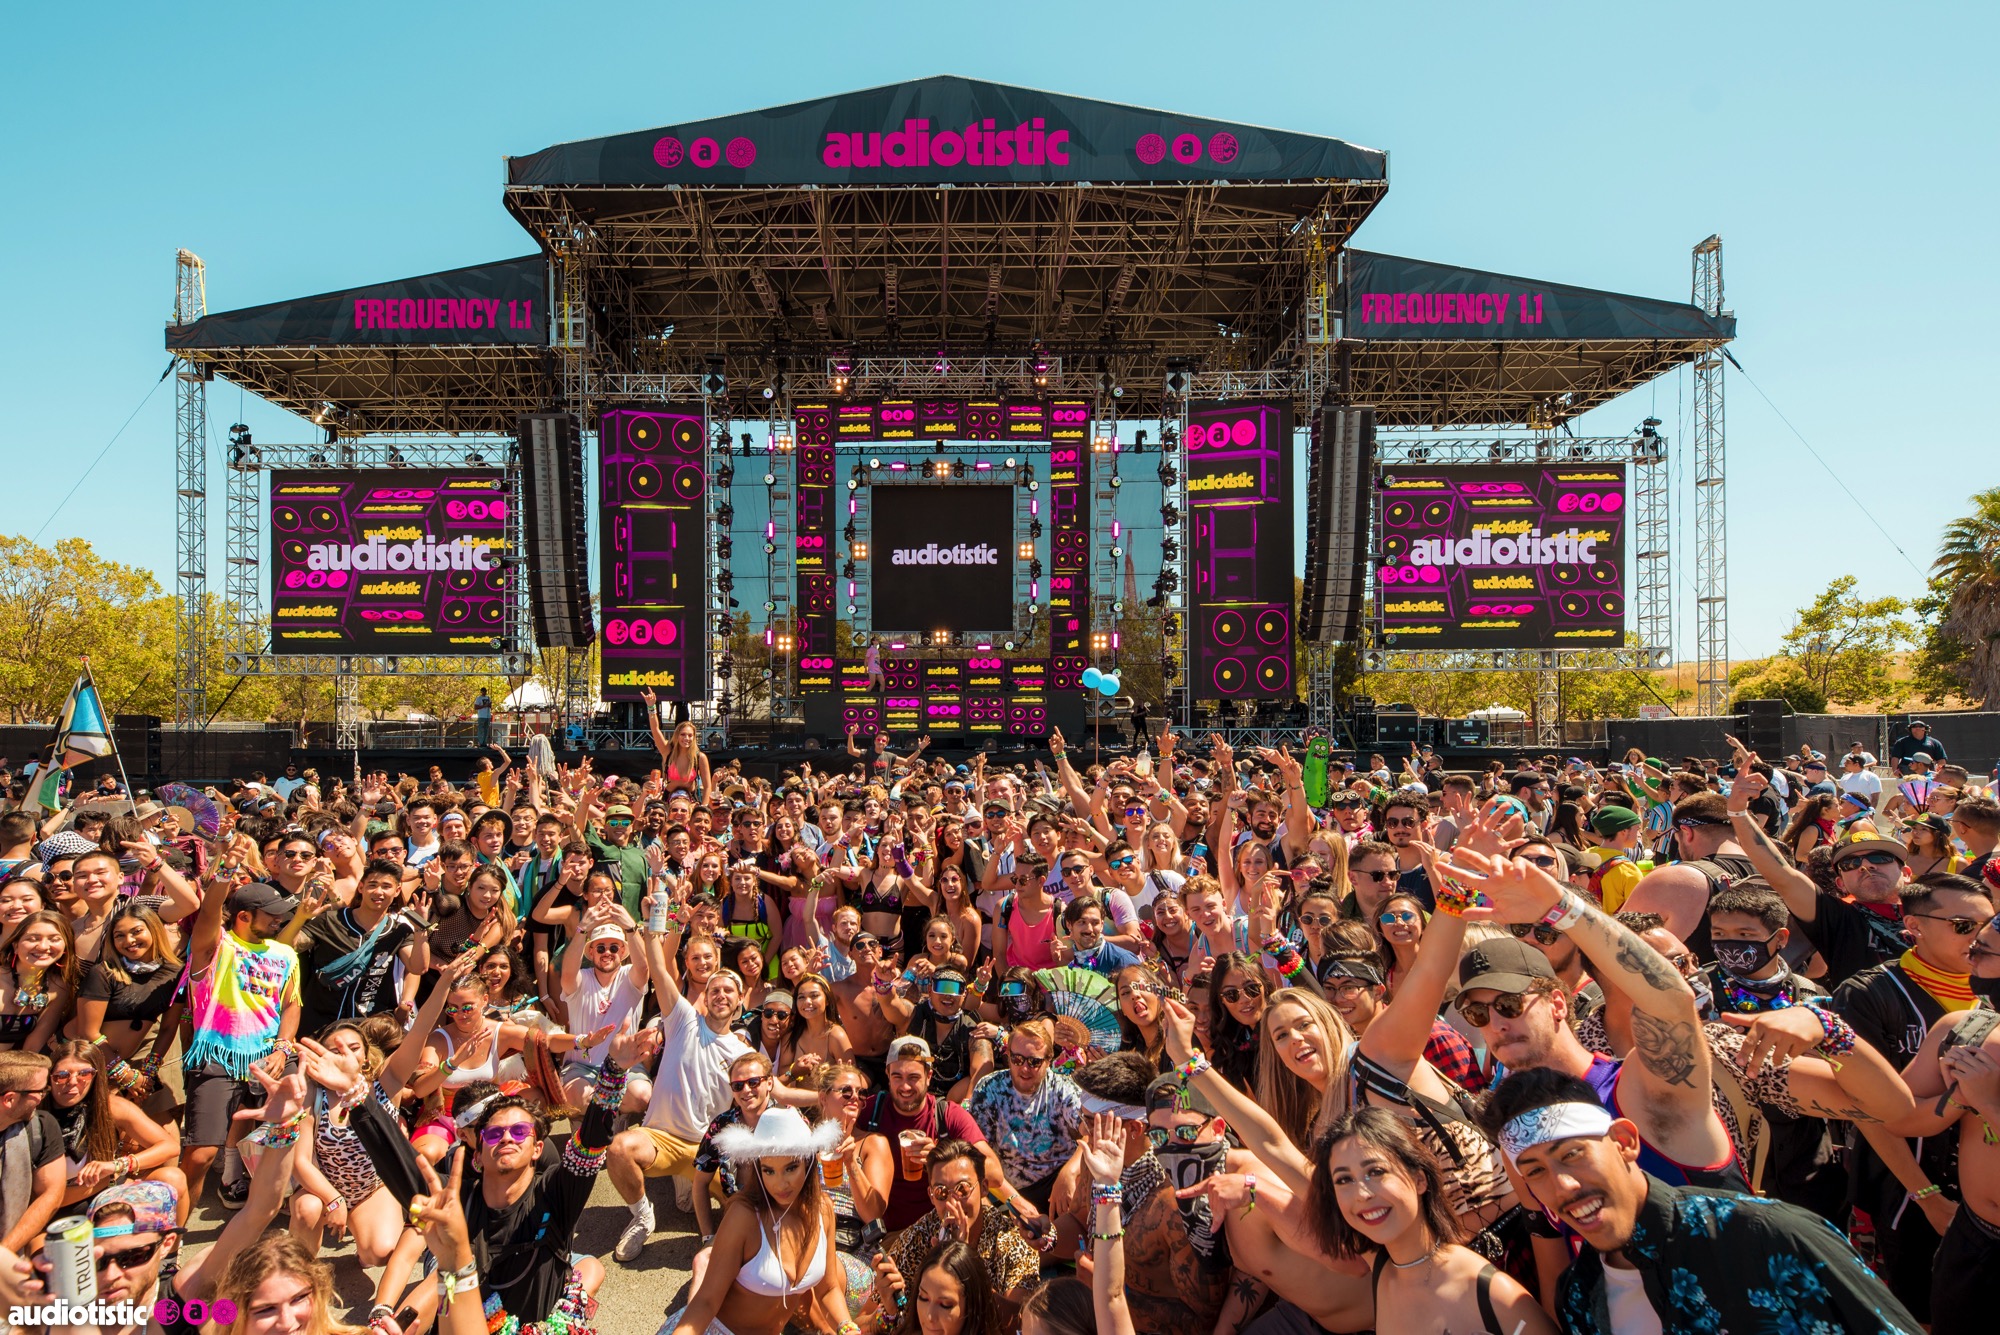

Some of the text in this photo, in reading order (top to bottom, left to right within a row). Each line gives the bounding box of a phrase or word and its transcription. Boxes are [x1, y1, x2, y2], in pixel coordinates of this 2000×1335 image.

[823, 118, 1069, 168] audiotistic
[354, 298, 532, 329] FREQUENCY 1.1
[1361, 293, 1543, 324] FREQUENCY 1.1
[307, 535, 490, 571] audiotistic
[891, 542, 998, 565] audiotistic
[1409, 528, 1597, 566] audiotistic
[360, 581, 421, 595] audiotistic
[1472, 575, 1535, 590] audiotistic
[277, 605, 338, 617] audiotistic
[1384, 600, 1446, 613] audiotistic
[607, 670, 675, 687] audiotistic
[238, 963, 283, 984] AREN'T
[335, 967, 363, 988] FILA
[74, 1244, 92, 1297] TRULY
